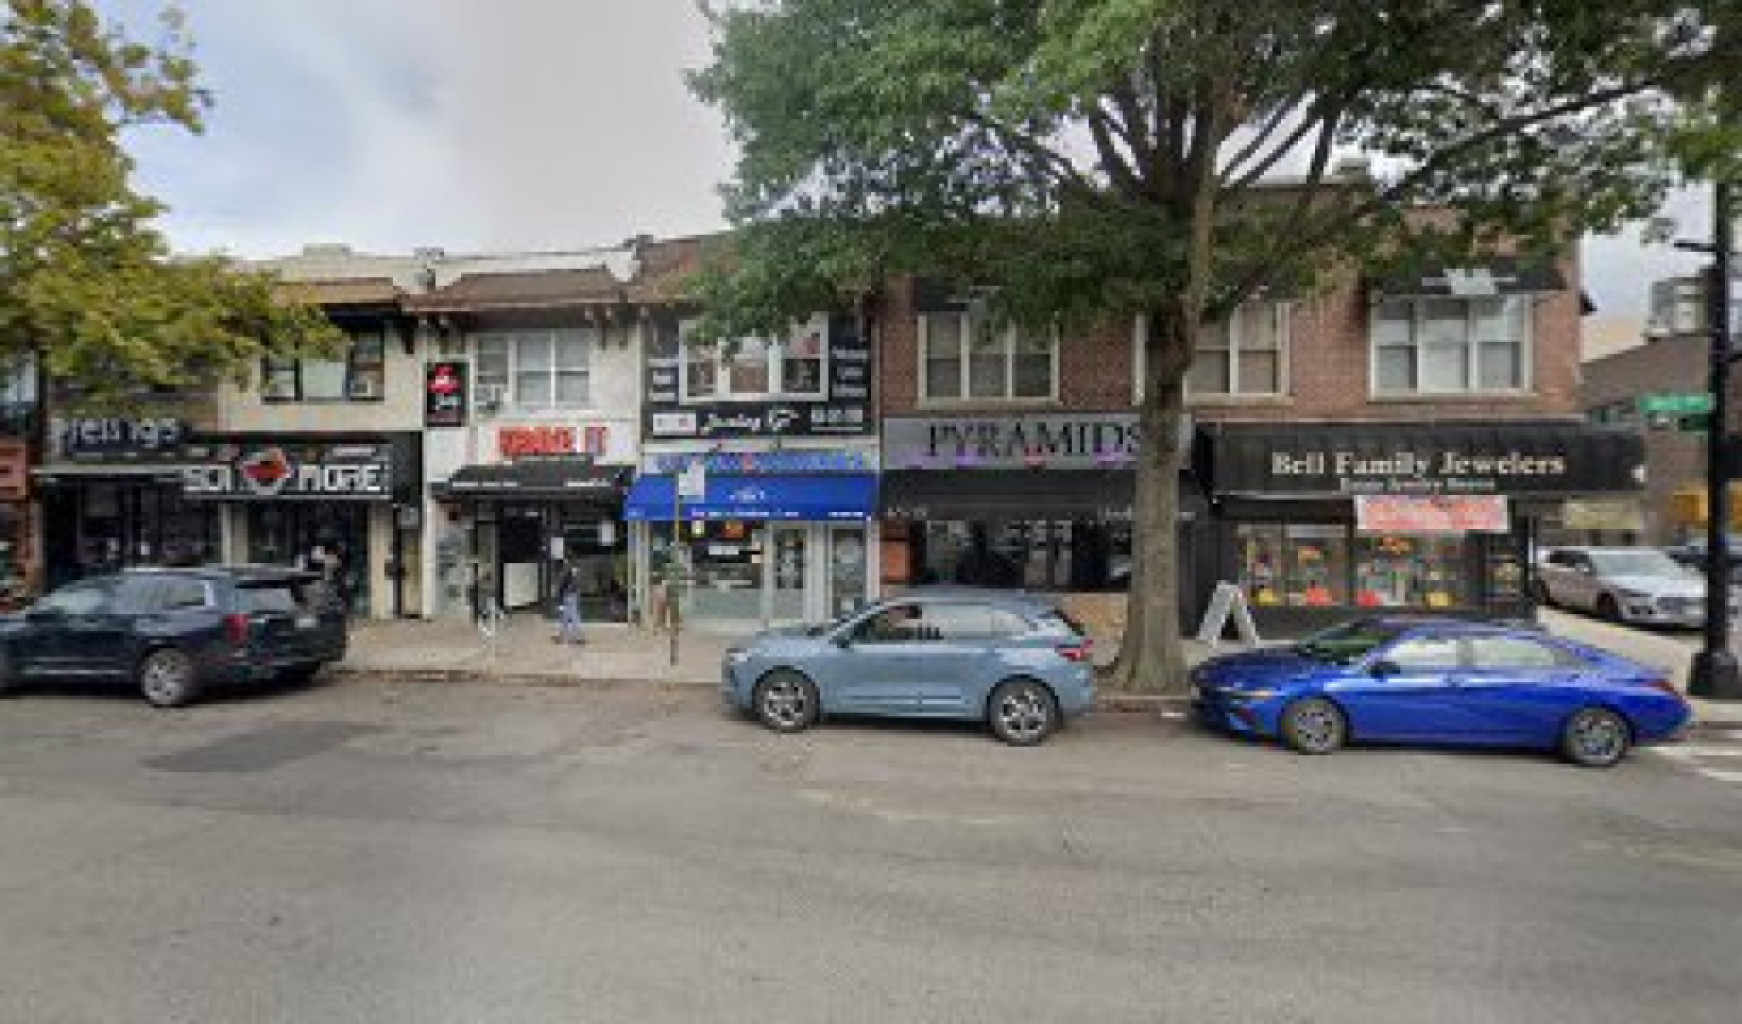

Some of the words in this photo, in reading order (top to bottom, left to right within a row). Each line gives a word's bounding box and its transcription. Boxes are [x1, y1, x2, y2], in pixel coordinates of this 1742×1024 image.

[928, 422, 1140, 457] PYRAMIDS
[299, 465, 381, 491] MORE
[1271, 452, 1325, 475] Bell
[1335, 451, 1431, 480] Family
[1438, 450, 1567, 475] Jewelers
